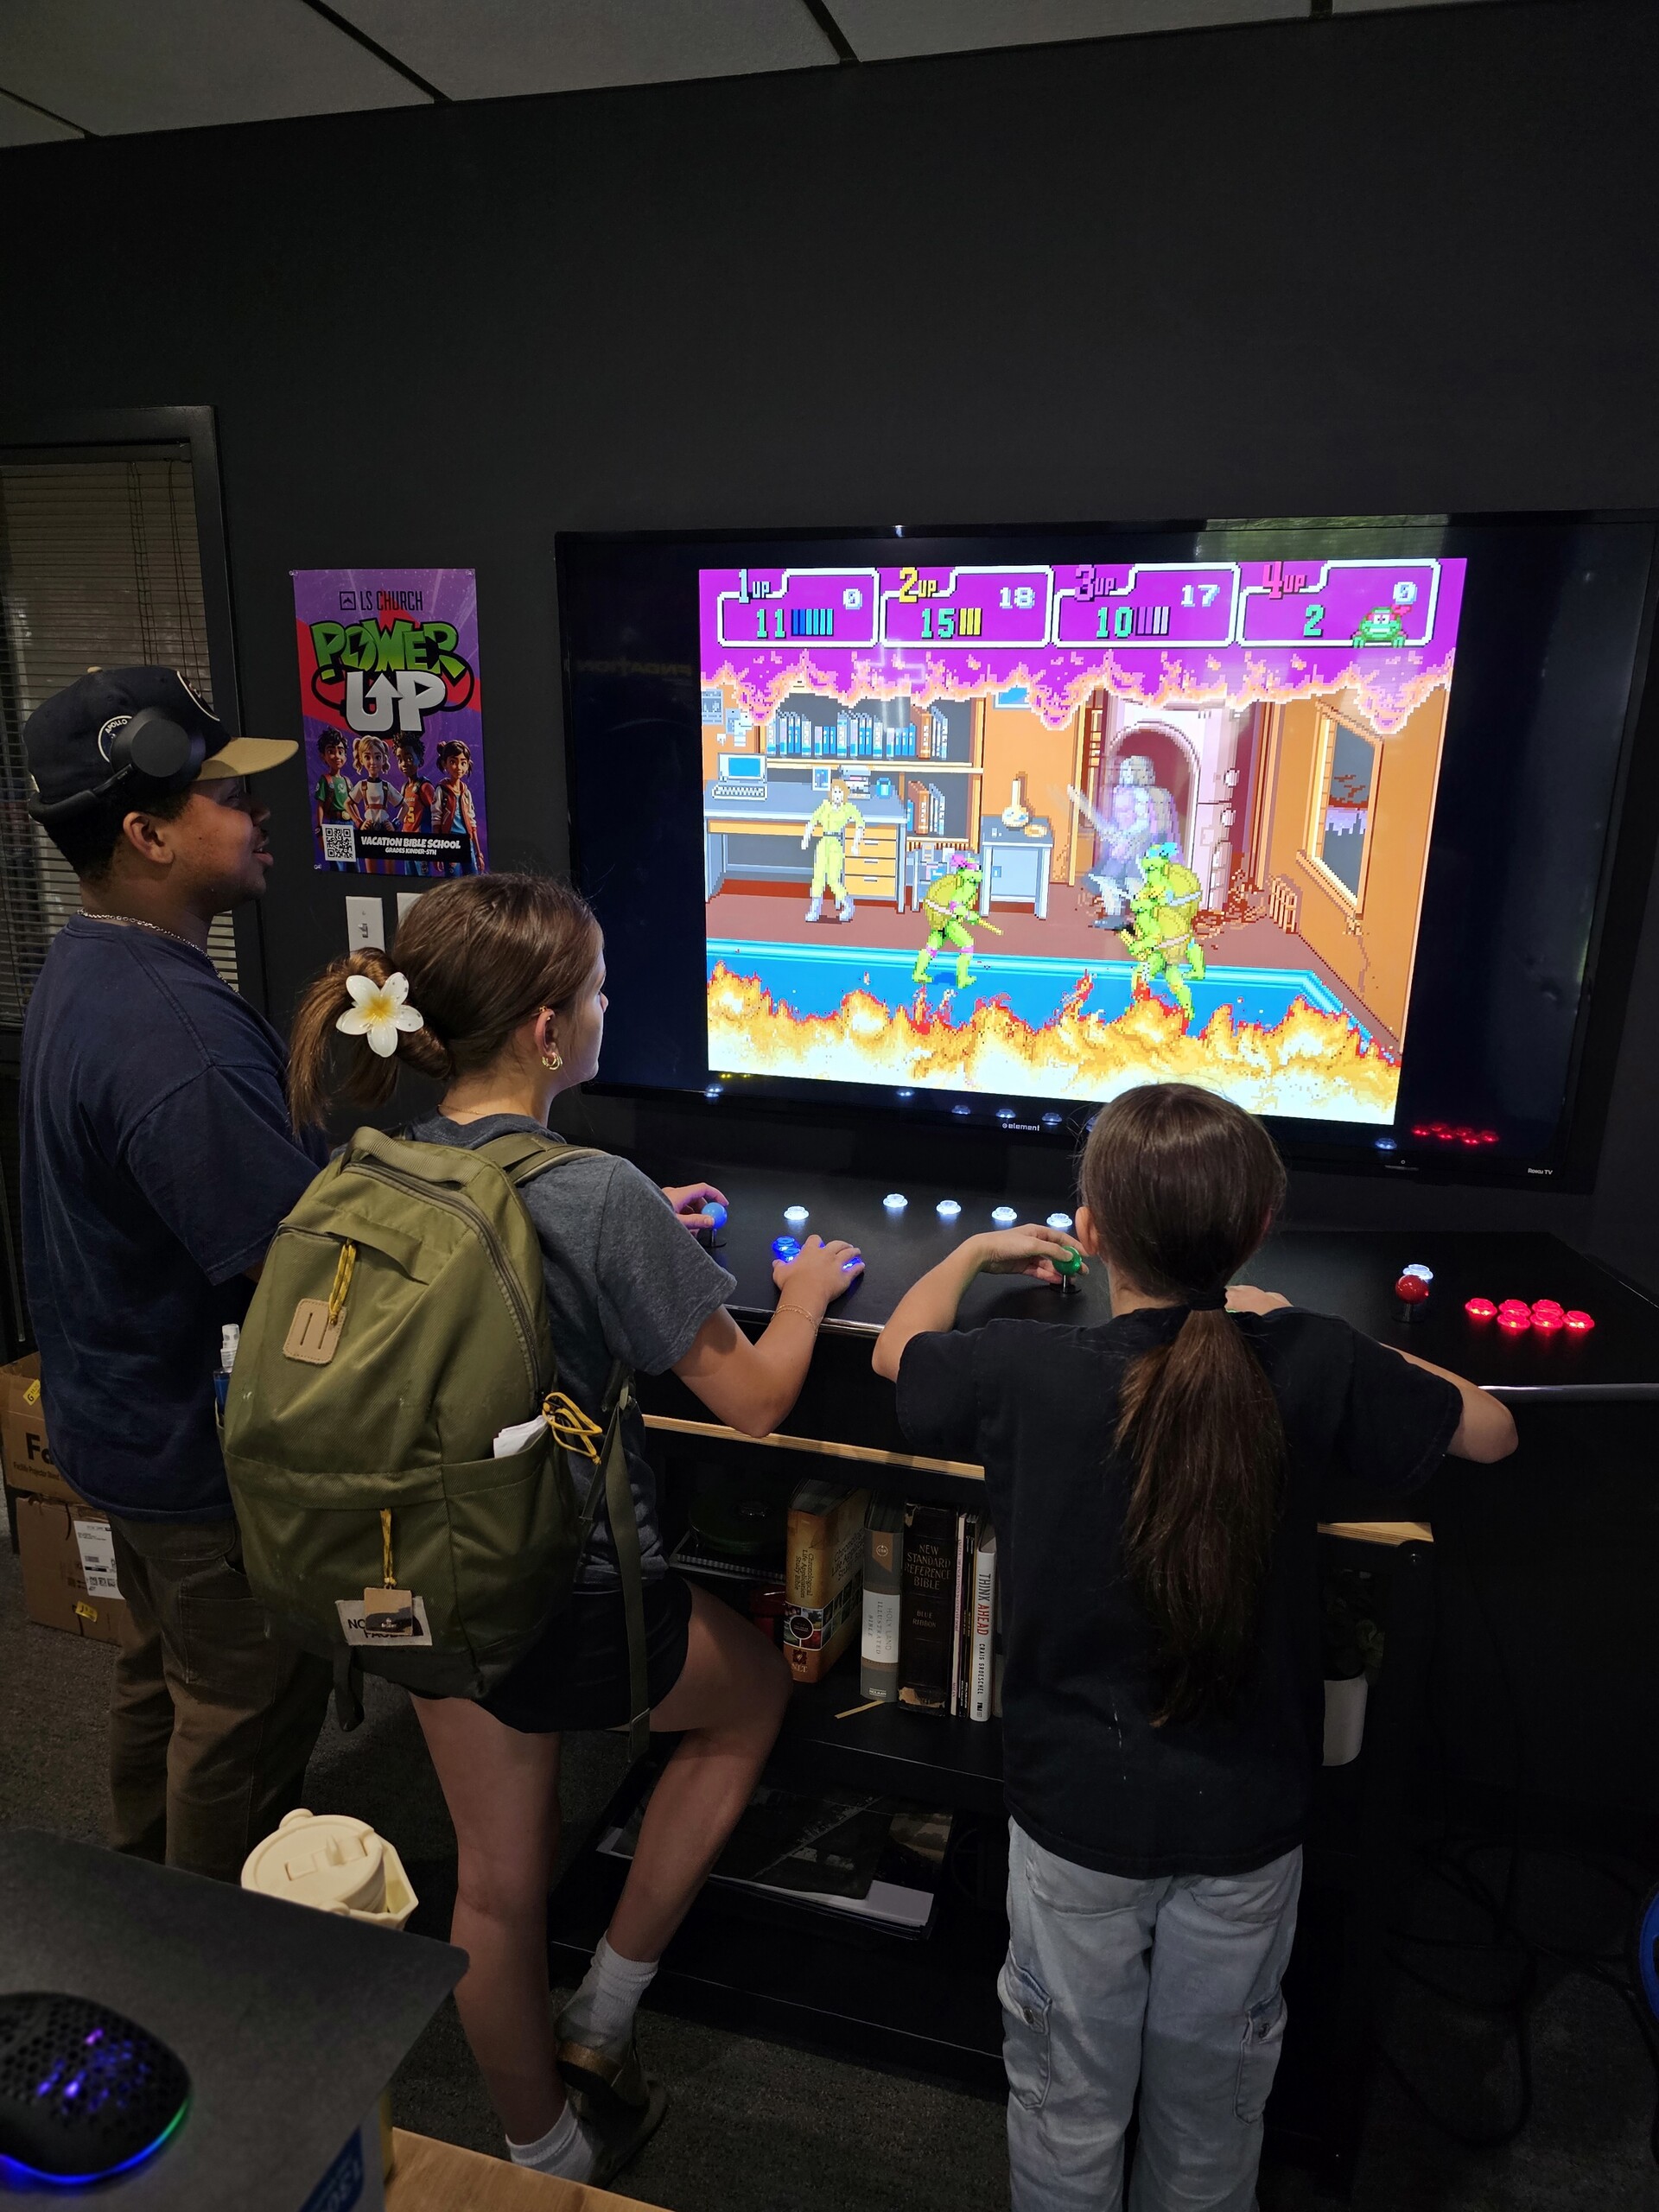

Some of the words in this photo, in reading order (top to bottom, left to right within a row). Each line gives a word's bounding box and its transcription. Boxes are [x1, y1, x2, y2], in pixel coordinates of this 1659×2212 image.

[738, 569, 770, 603] 1UP
[899, 568, 937, 602] 2UP
[1075, 565, 1116, 601] 3UP
[1262, 562, 1306, 598] 4UP
[361, 591, 373, 610] LS
[376, 591, 423, 611] CHURCH
[842, 588, 862, 609] 0
[999, 587, 1035, 609] 18
[1181, 584, 1220, 607] 17
[1394, 581, 1418, 604] 0
[756, 608, 785, 638] 11
[921, 607, 955, 639] 15
[1096, 607, 1134, 638] 10
[1305, 605, 1325, 637] 2
[311, 618, 466, 680] POWER
[346, 671, 447, 732] UP
[105, 719, 128, 734] APOLLO
[361, 836, 403, 847] VACATION
[403, 837, 427, 848] BIBLE
[427, 839, 461, 849] SCHOOL
[1008, 1122, 1039, 1131] element
[907, 1552, 950, 1568] STANDARD
[918, 1544, 939, 1554] NEW
[905, 1563, 950, 1580] REFERENCE
[913, 1576, 940, 1591] BIBLE
[977, 1573, 991, 1601] THINK
[912, 1618, 937, 1629] RIBBON
[916, 1610, 933, 1618] BLUE
[977, 1603, 989, 1636] AHEAD
[791, 1663, 808, 1673] NLT
